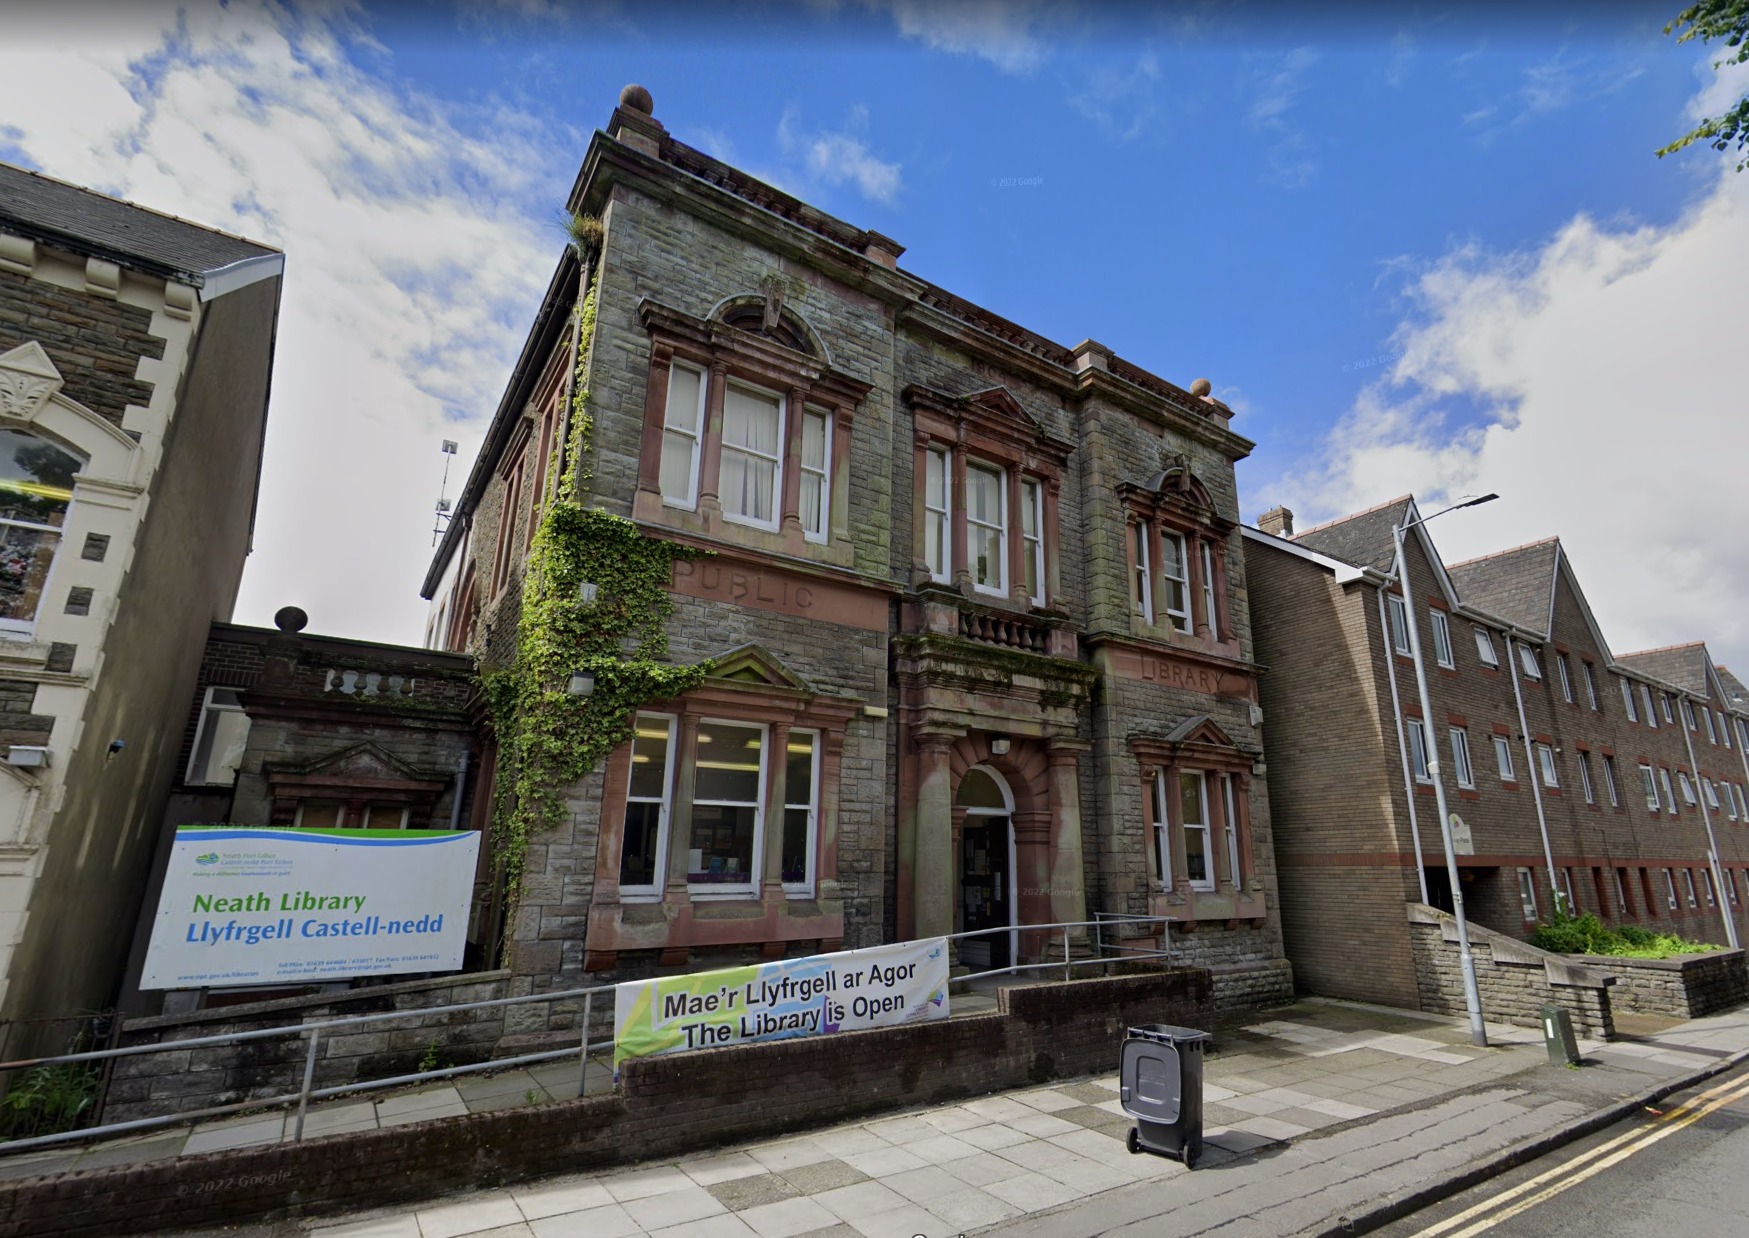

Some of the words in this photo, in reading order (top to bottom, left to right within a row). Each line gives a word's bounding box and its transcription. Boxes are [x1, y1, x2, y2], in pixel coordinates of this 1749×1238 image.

[671, 558, 814, 609] PUBLIC
[1140, 653, 1226, 694] LIBRARY
[193, 892, 271, 913] Neath
[280, 891, 367, 914] Library
[186, 918, 294, 946] Llyfrgell
[301, 914, 444, 938] Castell-nedd
[746, 970, 837, 1008] Llyfrgell
[843, 970, 864, 990] ar
[868, 963, 917, 988] Agor
[681, 1023, 732, 1049] The
[740, 1008, 821, 1038] Library
[828, 1001, 845, 1023] is
[852, 994, 905, 1021] Open
